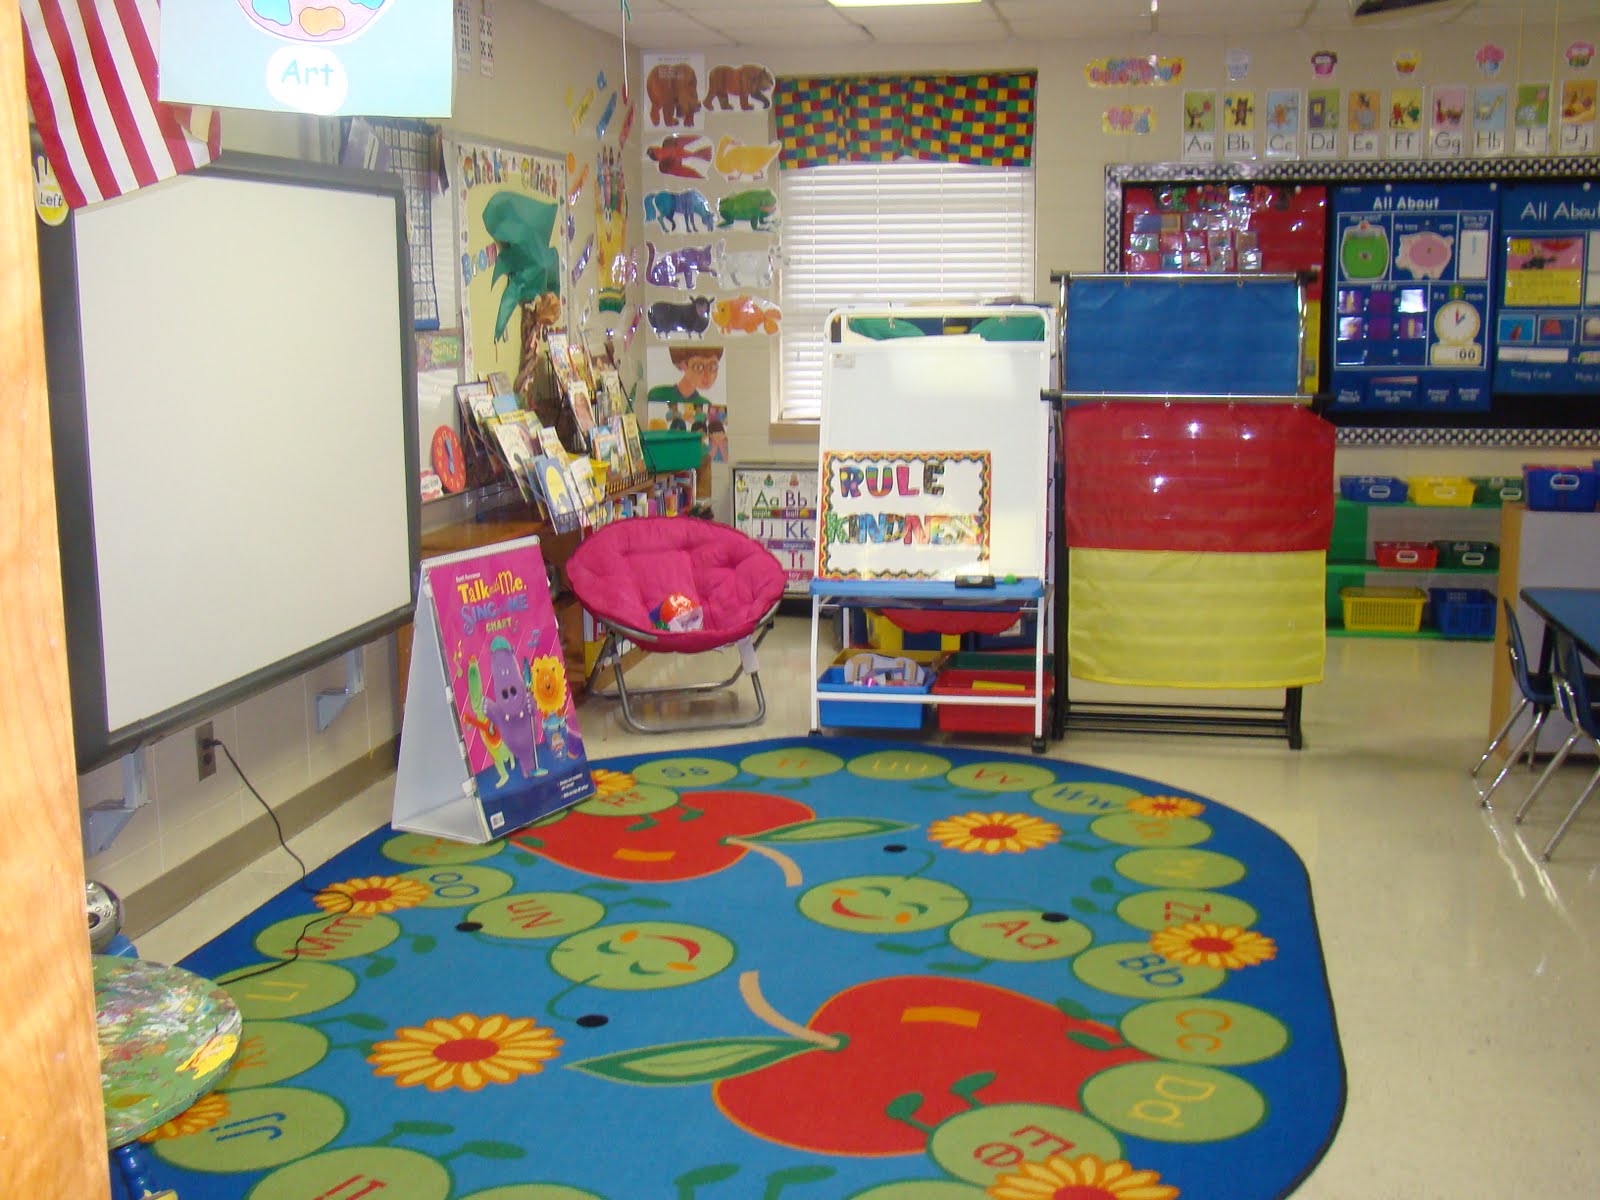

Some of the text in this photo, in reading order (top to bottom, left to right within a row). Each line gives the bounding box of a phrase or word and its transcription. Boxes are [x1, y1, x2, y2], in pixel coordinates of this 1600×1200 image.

[281, 59, 334, 87] Art
[1187, 134, 1212, 152] Aa
[1227, 134, 1251, 151] Bb
[1269, 135, 1292, 151] Cc
[1310, 133, 1335, 150] Dd
[1352, 134, 1374, 152] Ee
[1394, 132, 1412, 150] Ff
[1434, 131, 1461, 157] Gg
[39, 191, 63, 208] Left
[1372, 196, 1440, 211] All About
[1520, 201, 1547, 220] All
[839, 461, 945, 498] RULE
[754, 490, 780, 508] Aa
[785, 490, 808, 507] Bb
[785, 519, 810, 539] Kk
[788, 550, 805, 569] Tt
[457, 579, 490, 604] Talk
[461, 594, 529, 636] SING ME
[485, 616, 512, 634] CHART
[981, 918, 1061, 950] Aa
[1175, 1008, 1233, 1054] Cc
